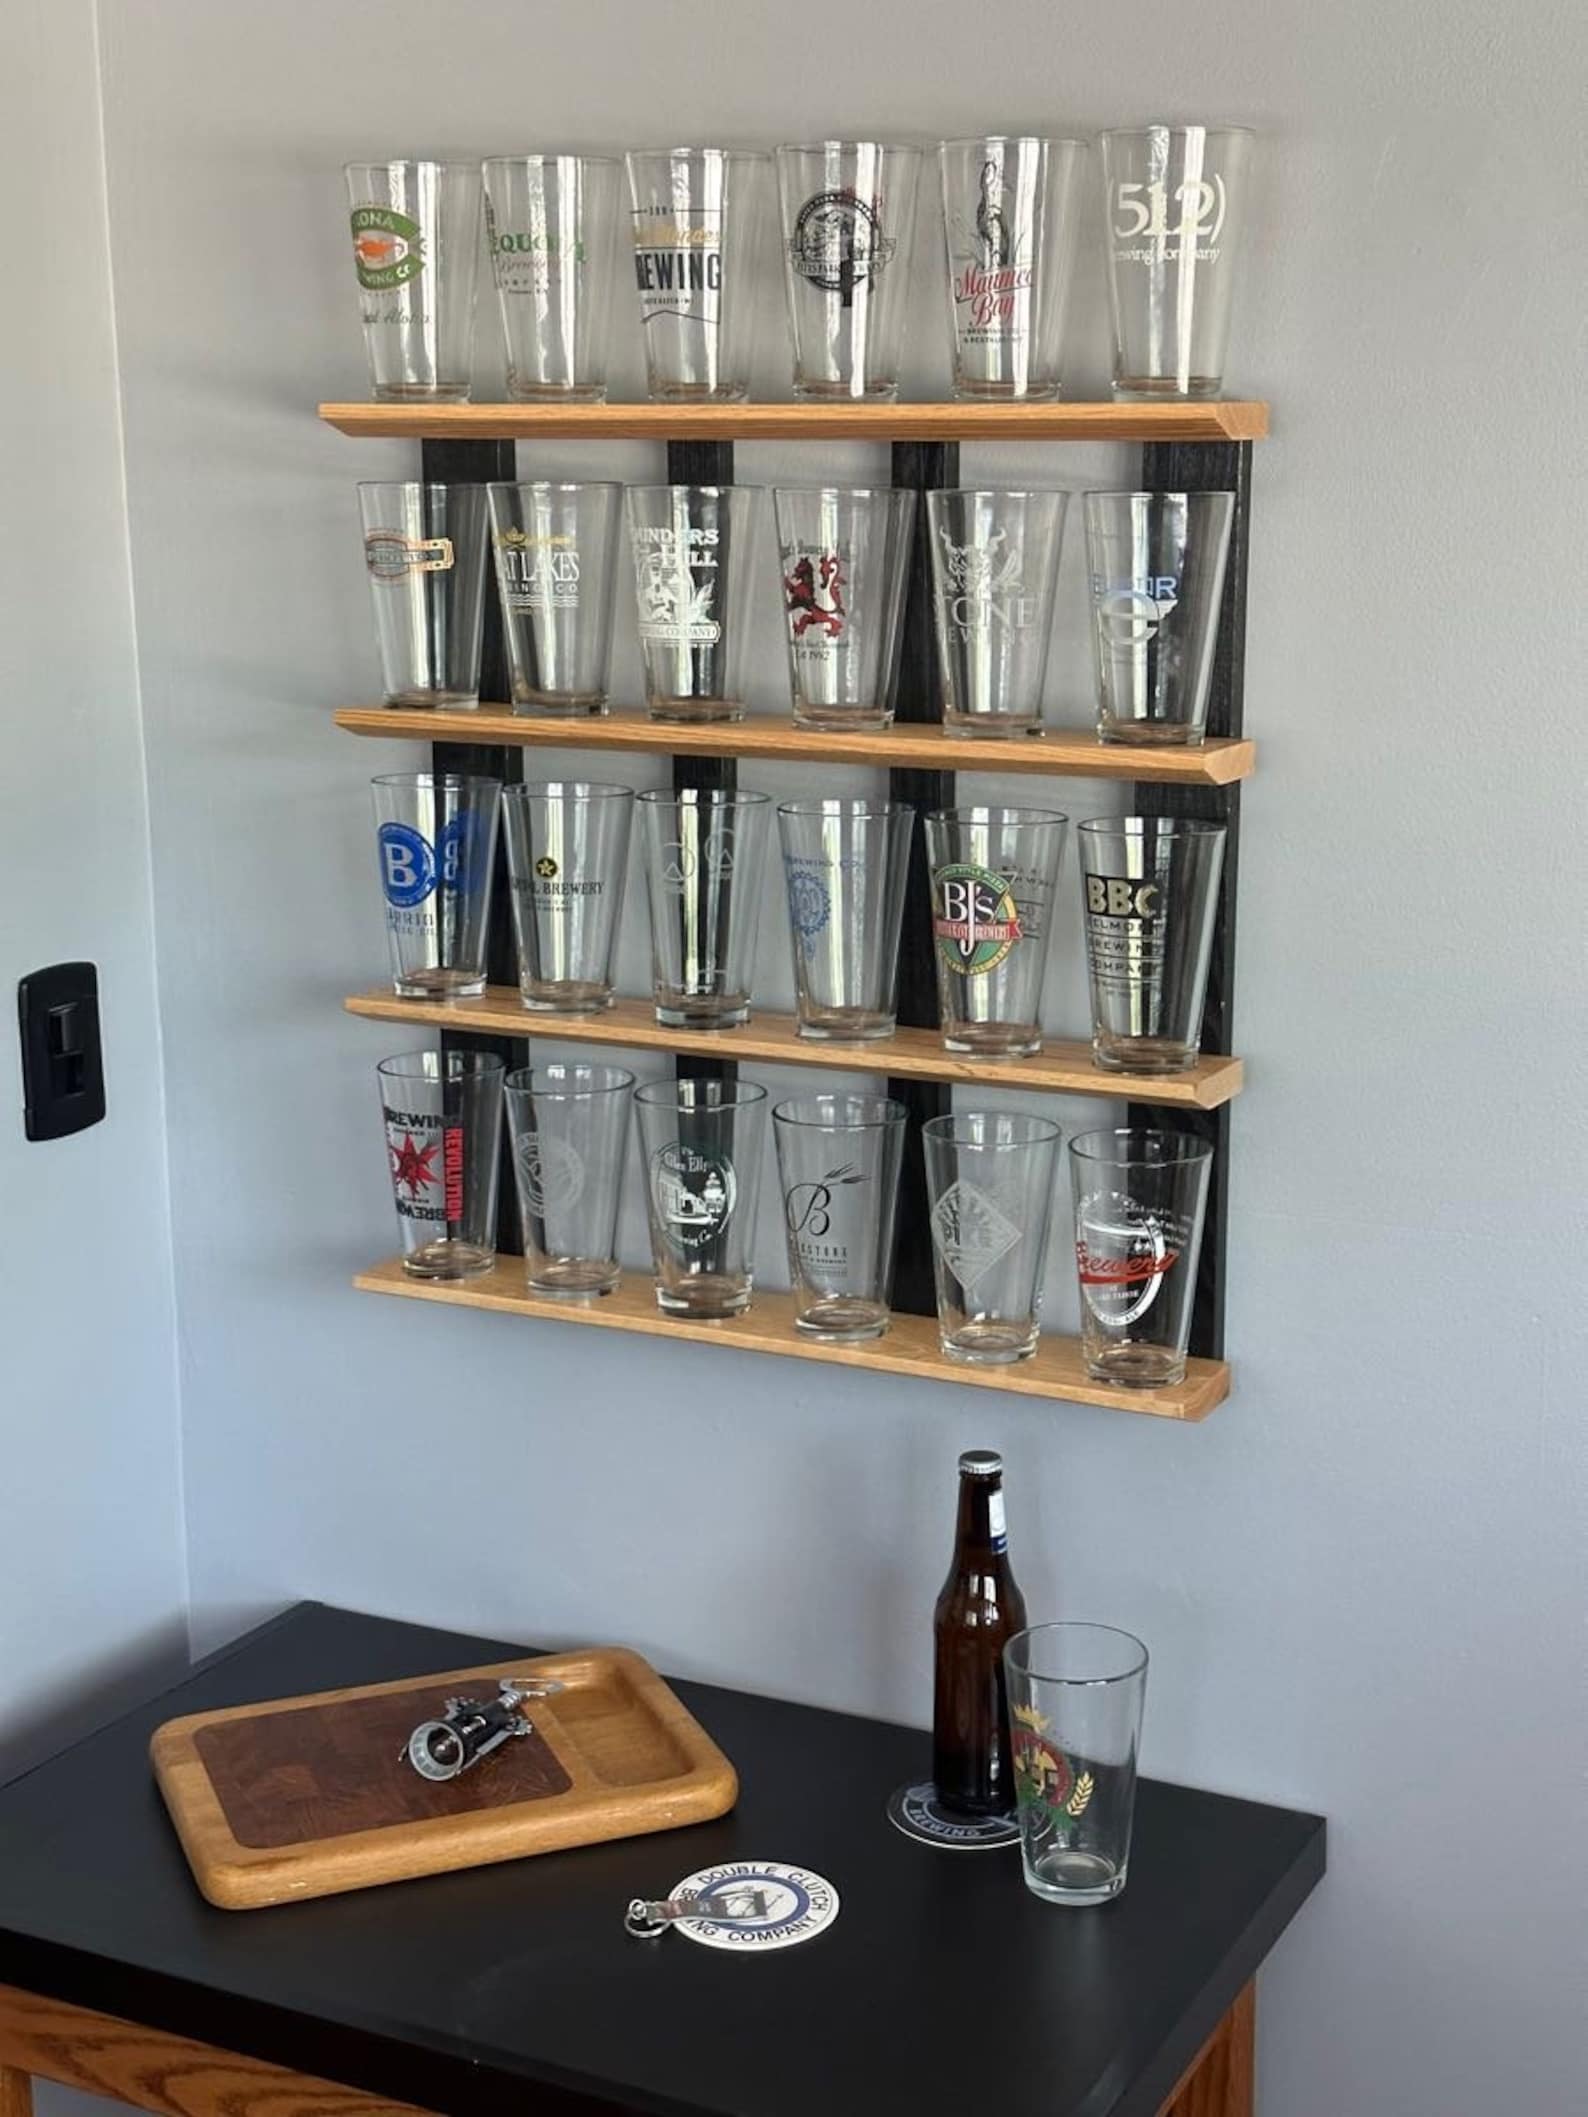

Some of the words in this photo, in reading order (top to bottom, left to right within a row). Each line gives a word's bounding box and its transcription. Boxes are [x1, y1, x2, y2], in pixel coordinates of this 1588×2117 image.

[520, 551, 580, 581] LAKES
[543, 882, 605, 896] BREWERY
[1086, 875, 1160, 920] BBC
[698, 1866, 778, 1885] DOUBLE
[787, 1872, 830, 1911] CLUTCH
[727, 1915, 817, 1943] COMPANY
